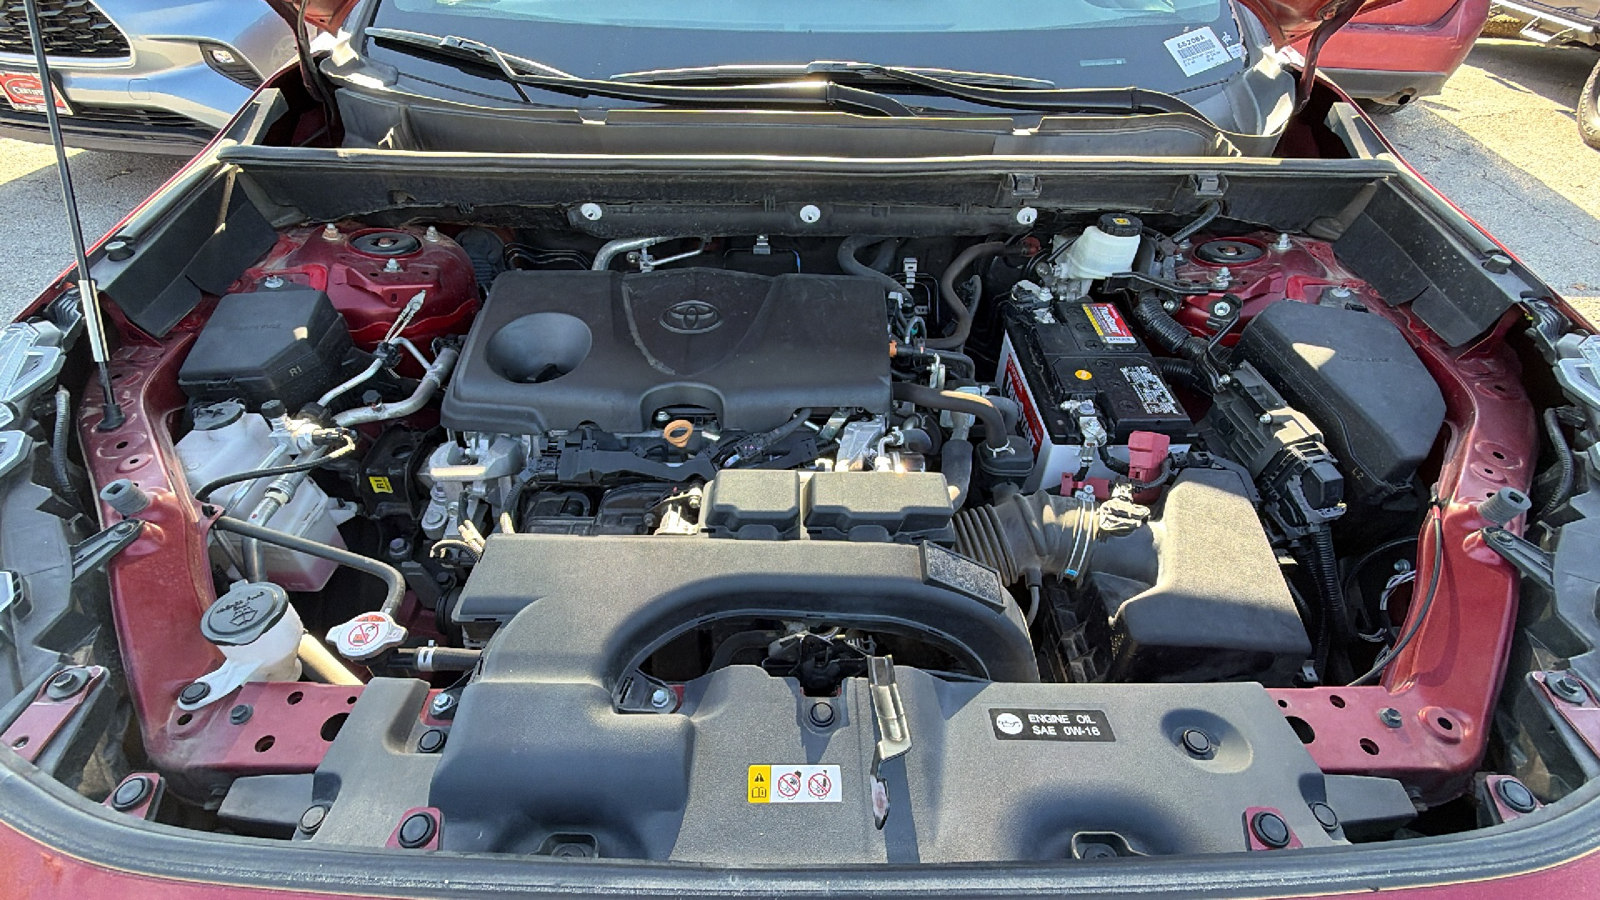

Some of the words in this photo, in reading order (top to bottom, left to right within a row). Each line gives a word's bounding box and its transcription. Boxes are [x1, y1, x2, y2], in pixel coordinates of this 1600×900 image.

[289, 365, 302, 377] R1
[1027, 713, 1070, 724] ENGINE
[1076, 714, 1097, 724] OIL
[1032, 725, 1057, 736] SAE
